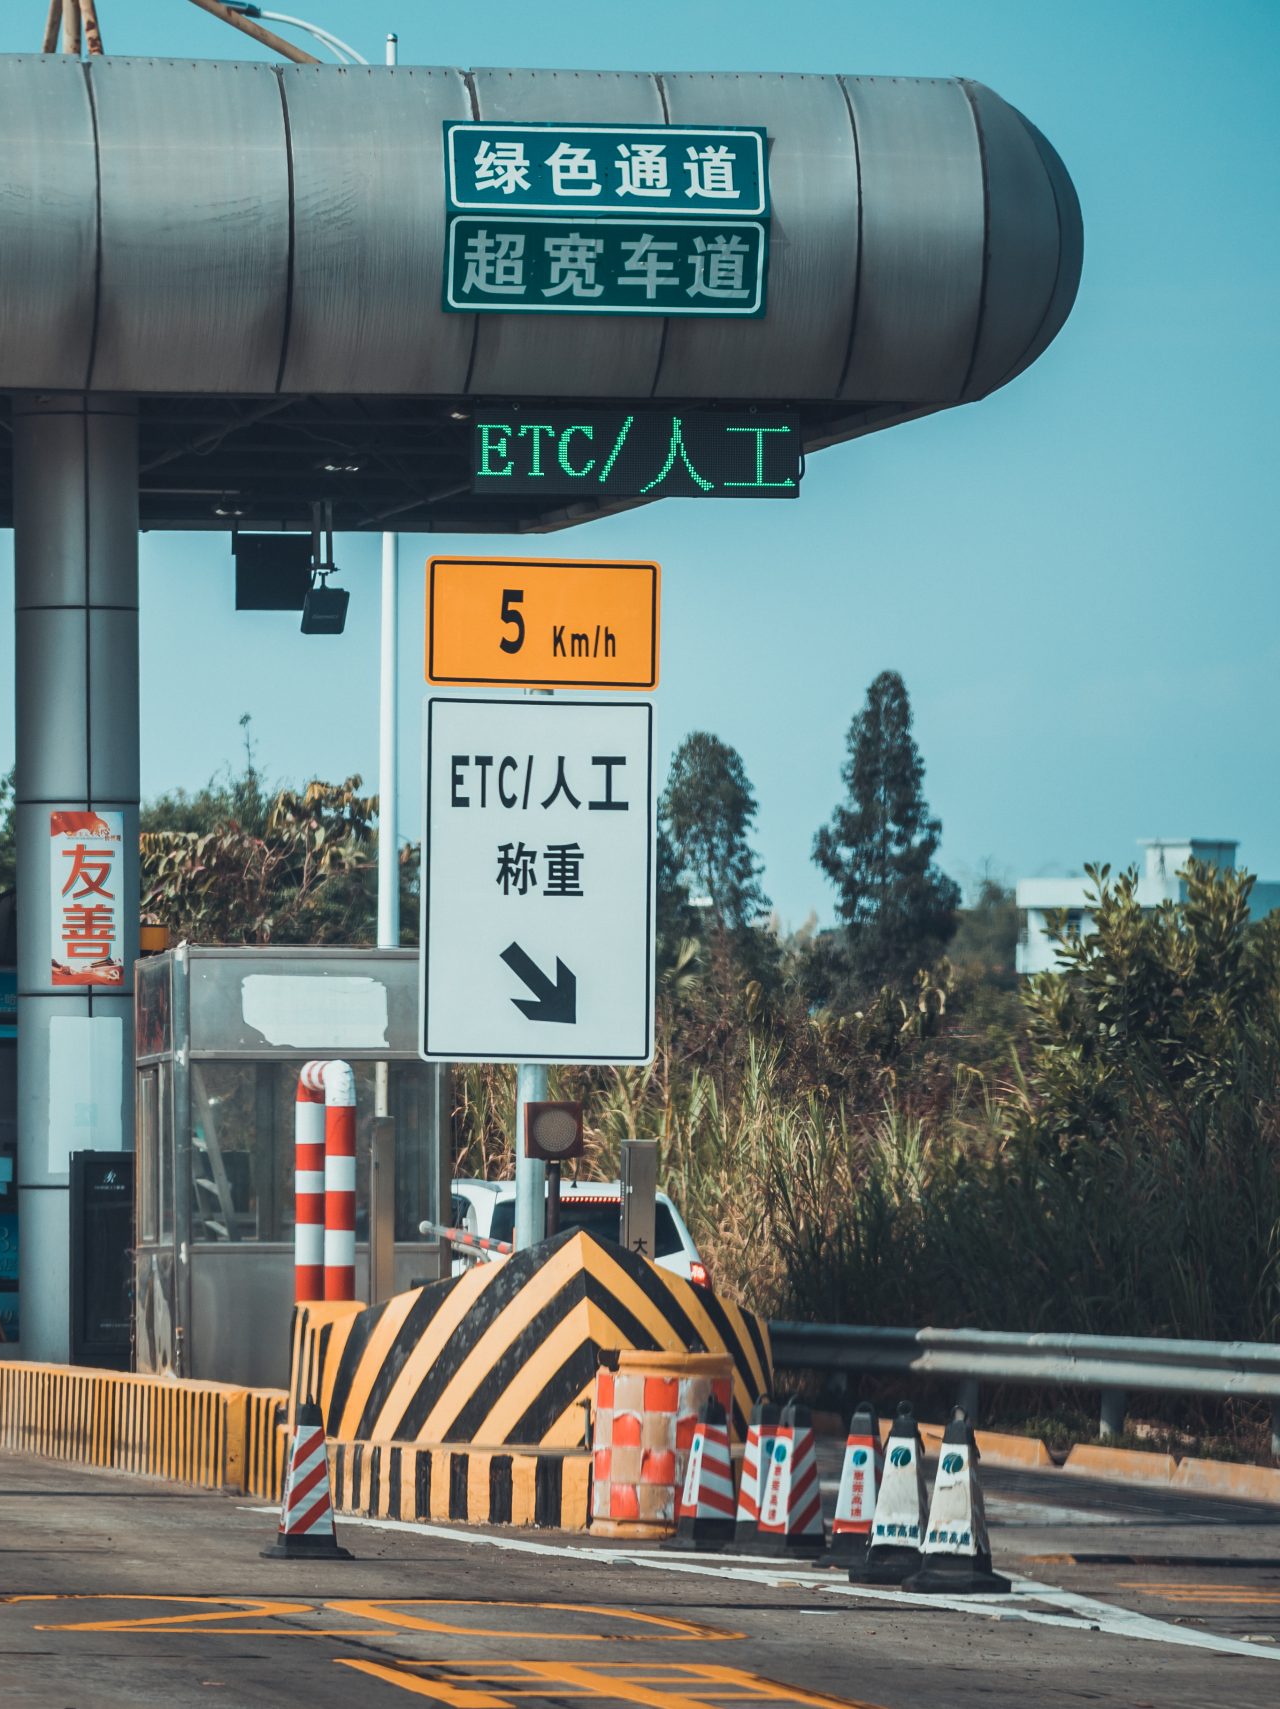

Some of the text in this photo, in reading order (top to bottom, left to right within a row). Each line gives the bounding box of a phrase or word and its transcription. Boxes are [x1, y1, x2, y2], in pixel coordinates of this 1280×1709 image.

[473, 140, 742, 201] 绿色通道
[461, 229, 752, 301] 超宽车道
[476, 415, 797, 494] ETC/人工
[498, 588, 618, 659] 5 Km/h
[450, 753, 631, 812] ETC/人工
[61, 843, 116, 960] 友善
[495, 841, 586, 898] 称重
